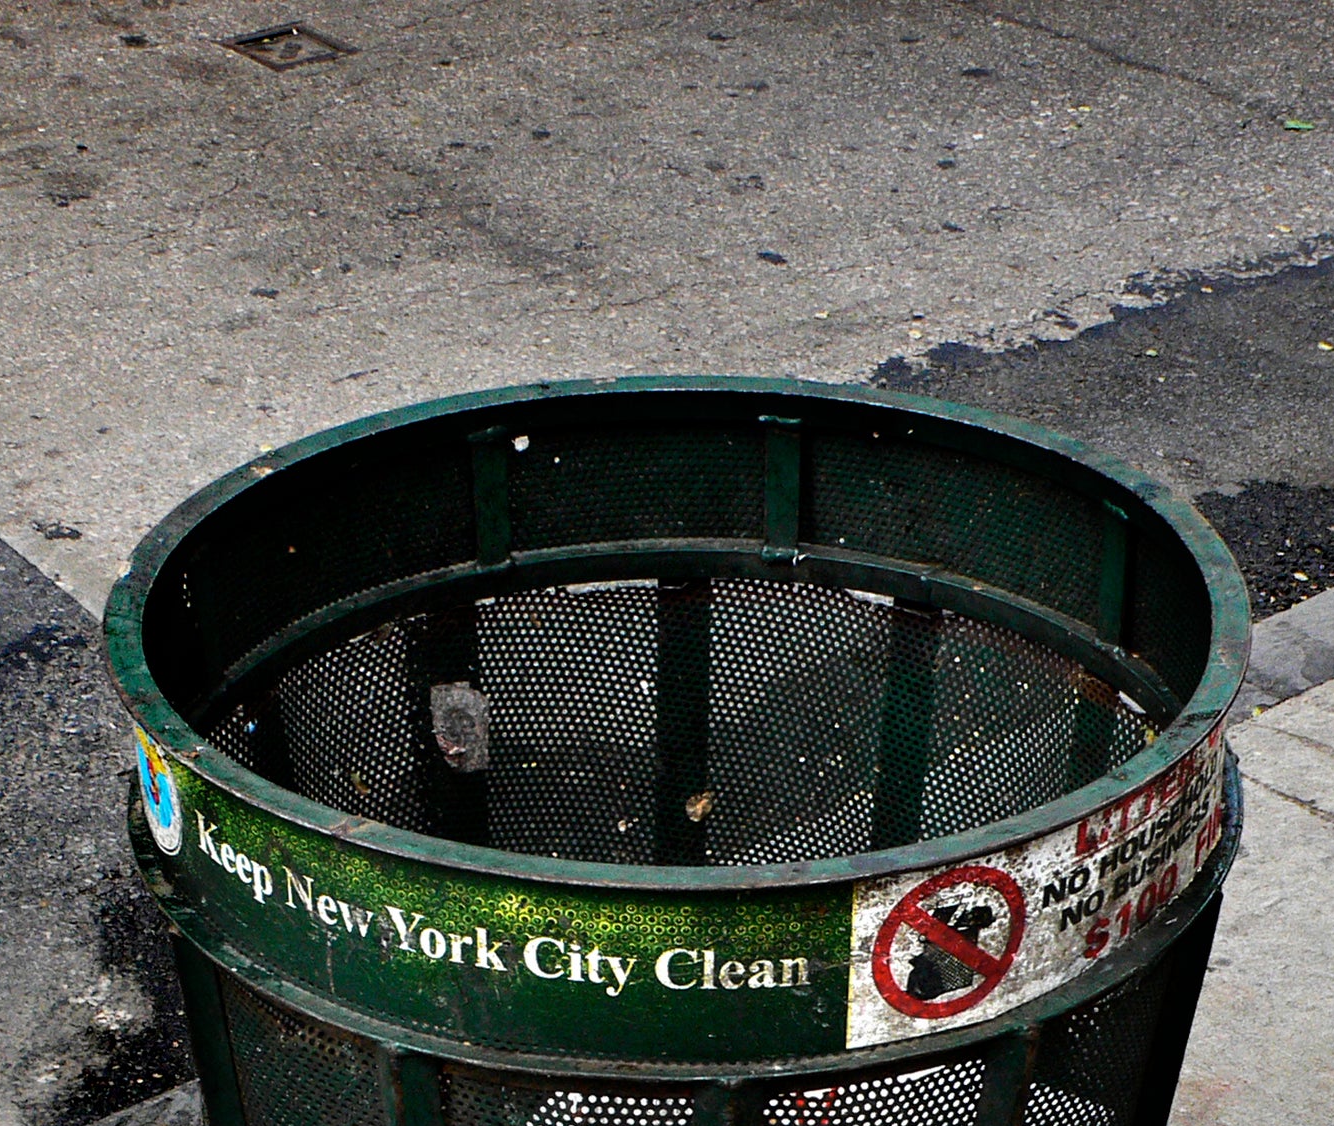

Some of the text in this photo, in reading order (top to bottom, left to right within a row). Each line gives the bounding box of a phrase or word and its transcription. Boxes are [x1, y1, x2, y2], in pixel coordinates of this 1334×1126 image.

[194, 808, 812, 998] Keep New York City Clean
[1042, 867, 1091, 909] NO
[1059, 791, 1211, 932] NO BUSINESS
